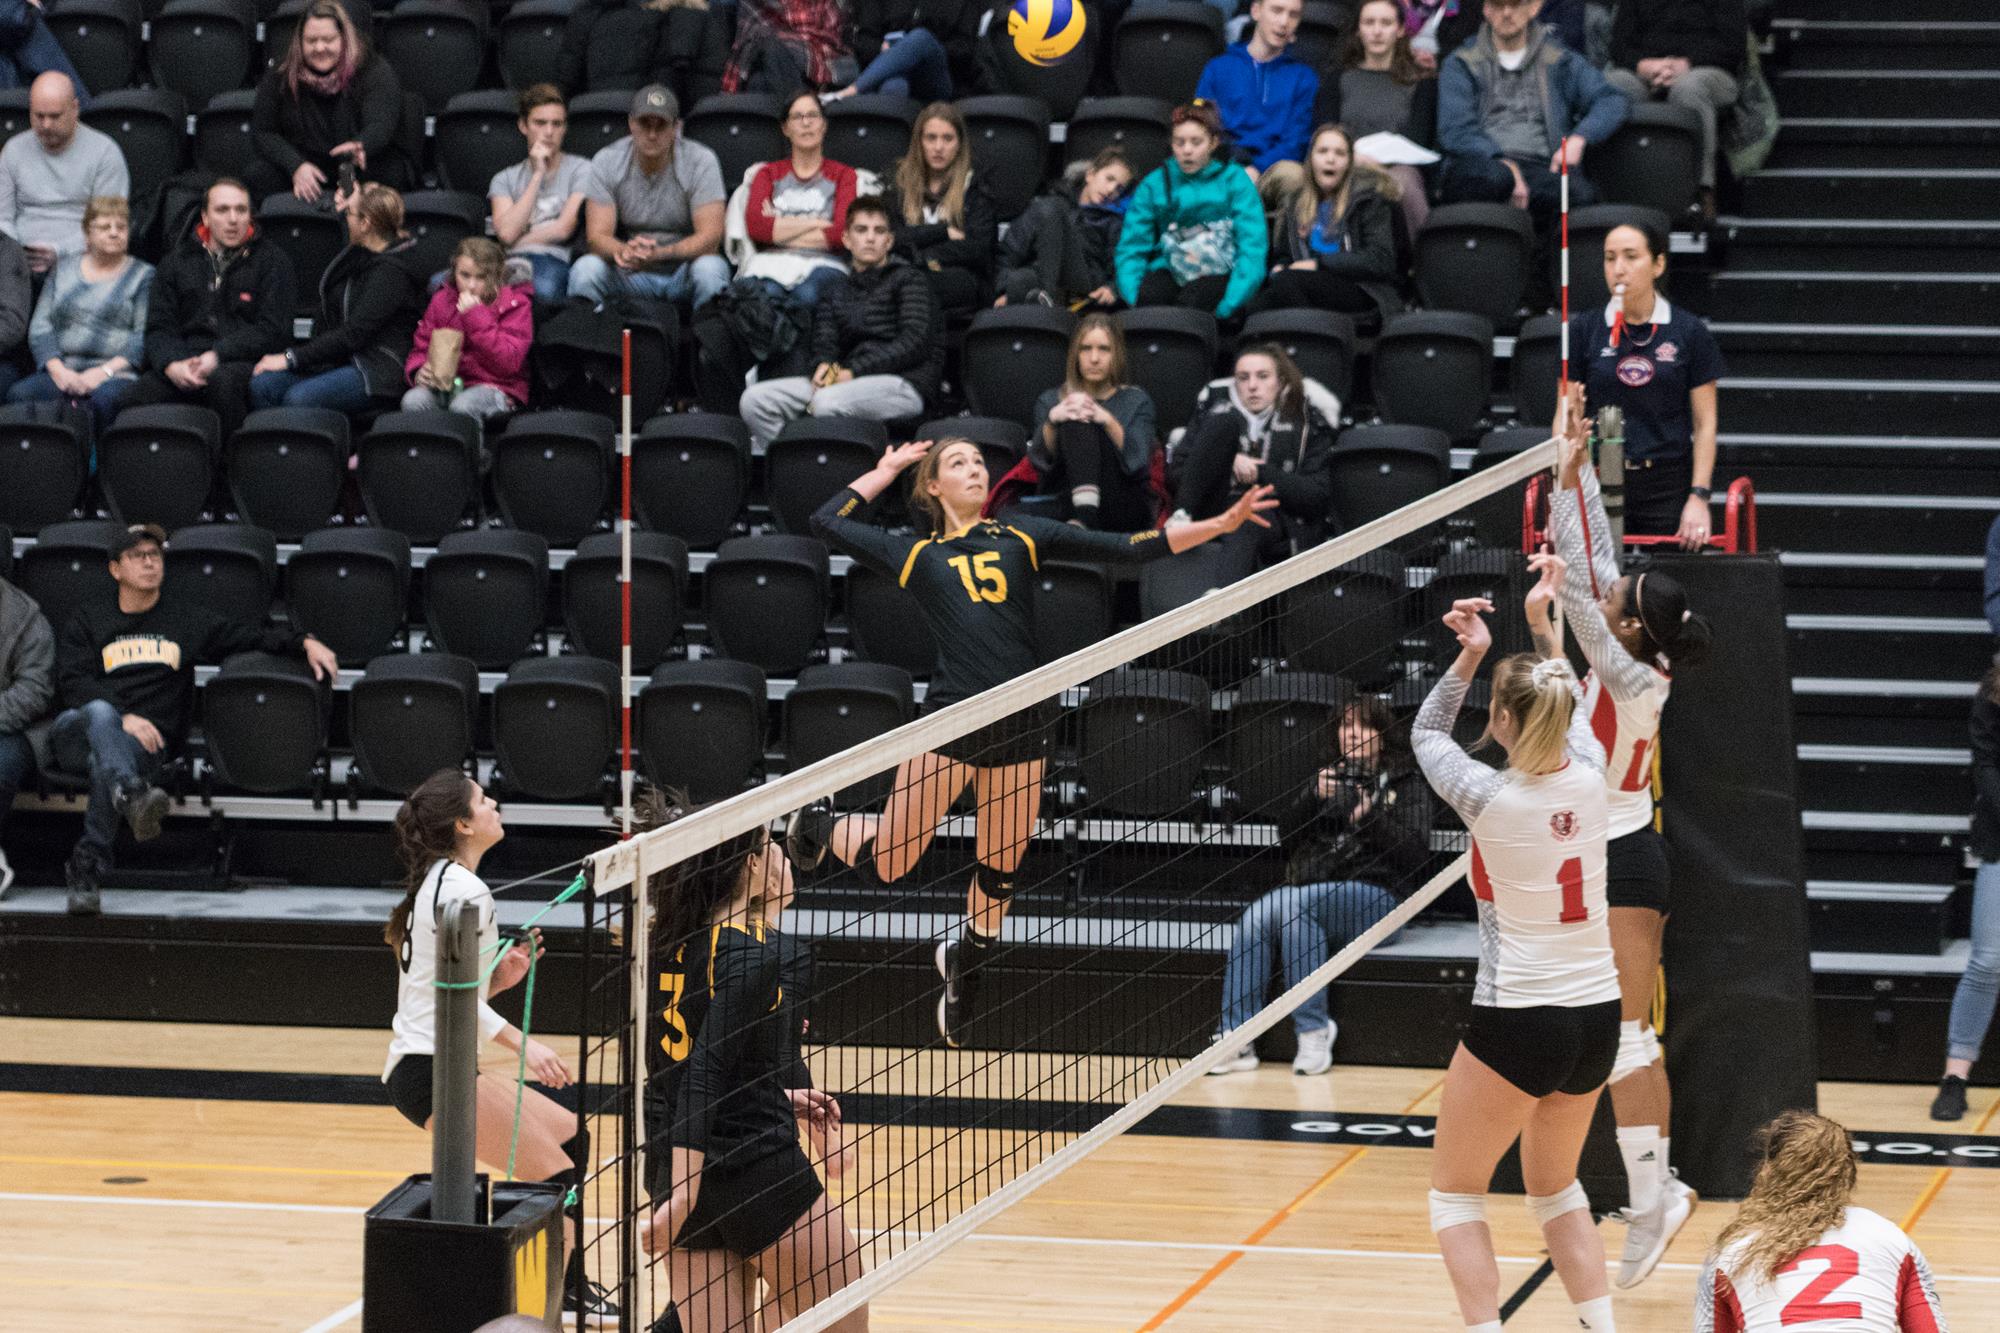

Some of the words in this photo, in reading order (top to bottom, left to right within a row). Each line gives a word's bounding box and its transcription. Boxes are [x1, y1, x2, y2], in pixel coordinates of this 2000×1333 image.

[947, 551, 1008, 603] 15
[1556, 856, 1588, 924] 1
[659, 972, 694, 1062] 3
[1773, 1244, 1863, 1327] 2
